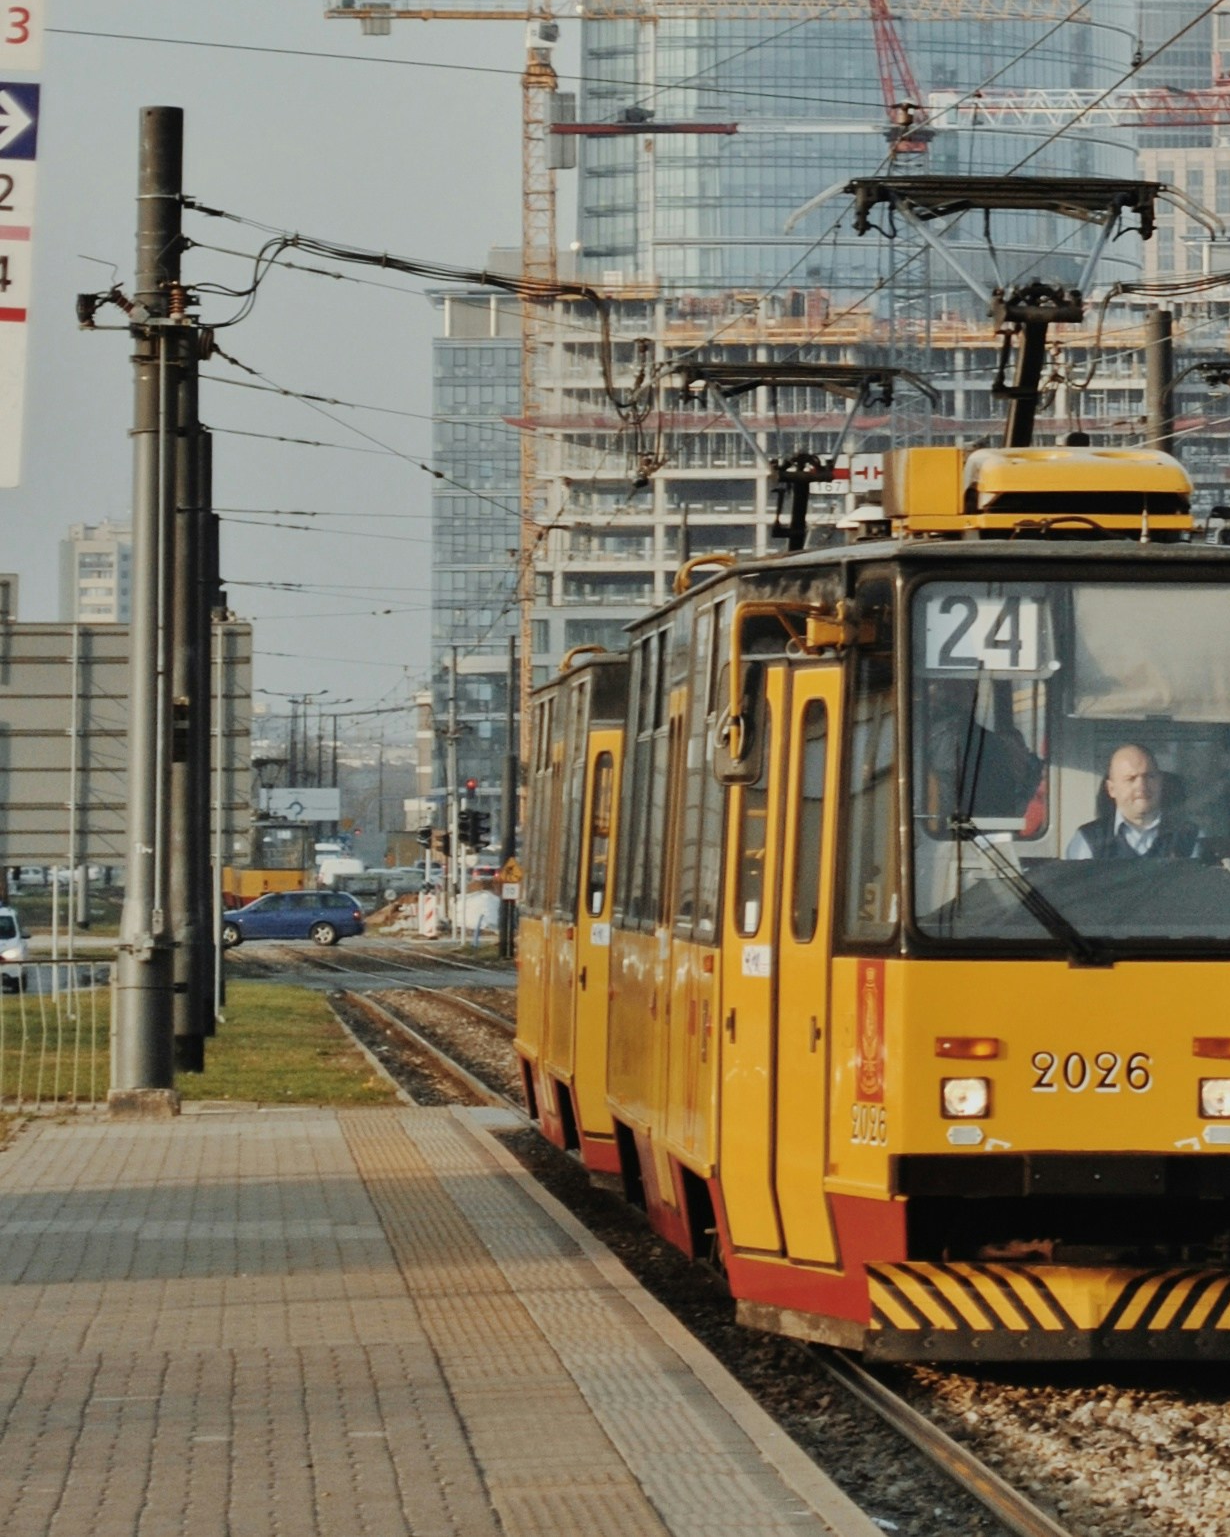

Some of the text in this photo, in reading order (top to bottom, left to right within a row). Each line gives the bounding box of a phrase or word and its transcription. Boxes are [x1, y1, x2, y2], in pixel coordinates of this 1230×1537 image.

[4, 6, 30, 45] 3
[937, 594, 1023, 668] 24
[1030, 1050, 1154, 1094] 2026
[851, 1103, 887, 1146] 2026
